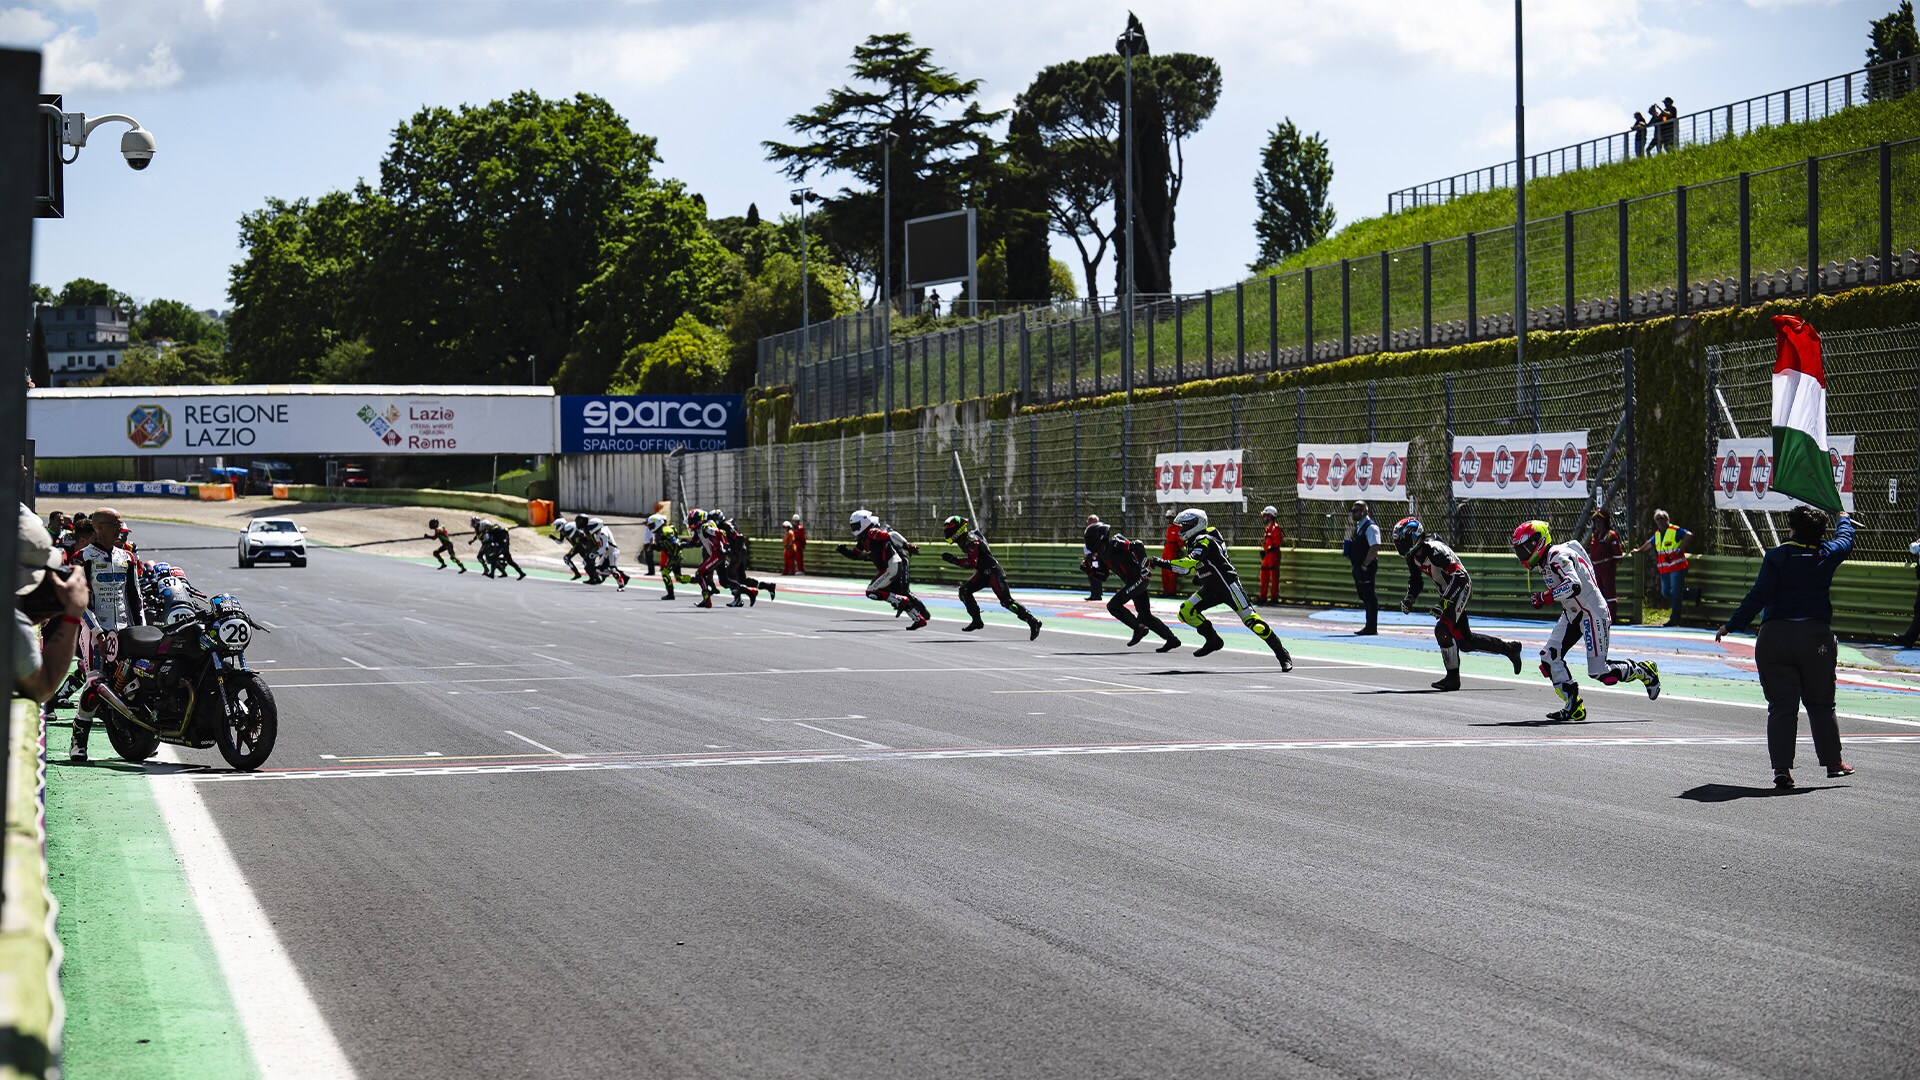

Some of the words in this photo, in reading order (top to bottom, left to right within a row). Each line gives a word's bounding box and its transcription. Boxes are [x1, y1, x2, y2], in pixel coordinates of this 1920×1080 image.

[185, 404, 288, 424] REGIONE
[409, 406, 454, 421] Lazio
[583, 401, 727, 436] sparco
[186, 427, 256, 447] LAZIO
[408, 435, 457, 449] Rome
[583, 438, 727, 451] SPARCO-OFFICIAL.COM
[1303, 464, 1319, 479] NILS
[1328, 464, 1346, 479] NILS
[1356, 464, 1373, 479] NILS
[1384, 464, 1402, 479] NILS
[1460, 459, 1480, 475] NILS
[1494, 459, 1514, 475] NILS
[1527, 458, 1547, 474] NILS
[1560, 458, 1580, 474] NILS
[1721, 465, 1740, 483] NILS
[1751, 465, 1770, 483] NILS
[1890, 490, 1895, 502] 3
[163, 578, 177, 588] 87
[225, 623, 248, 643] 28
